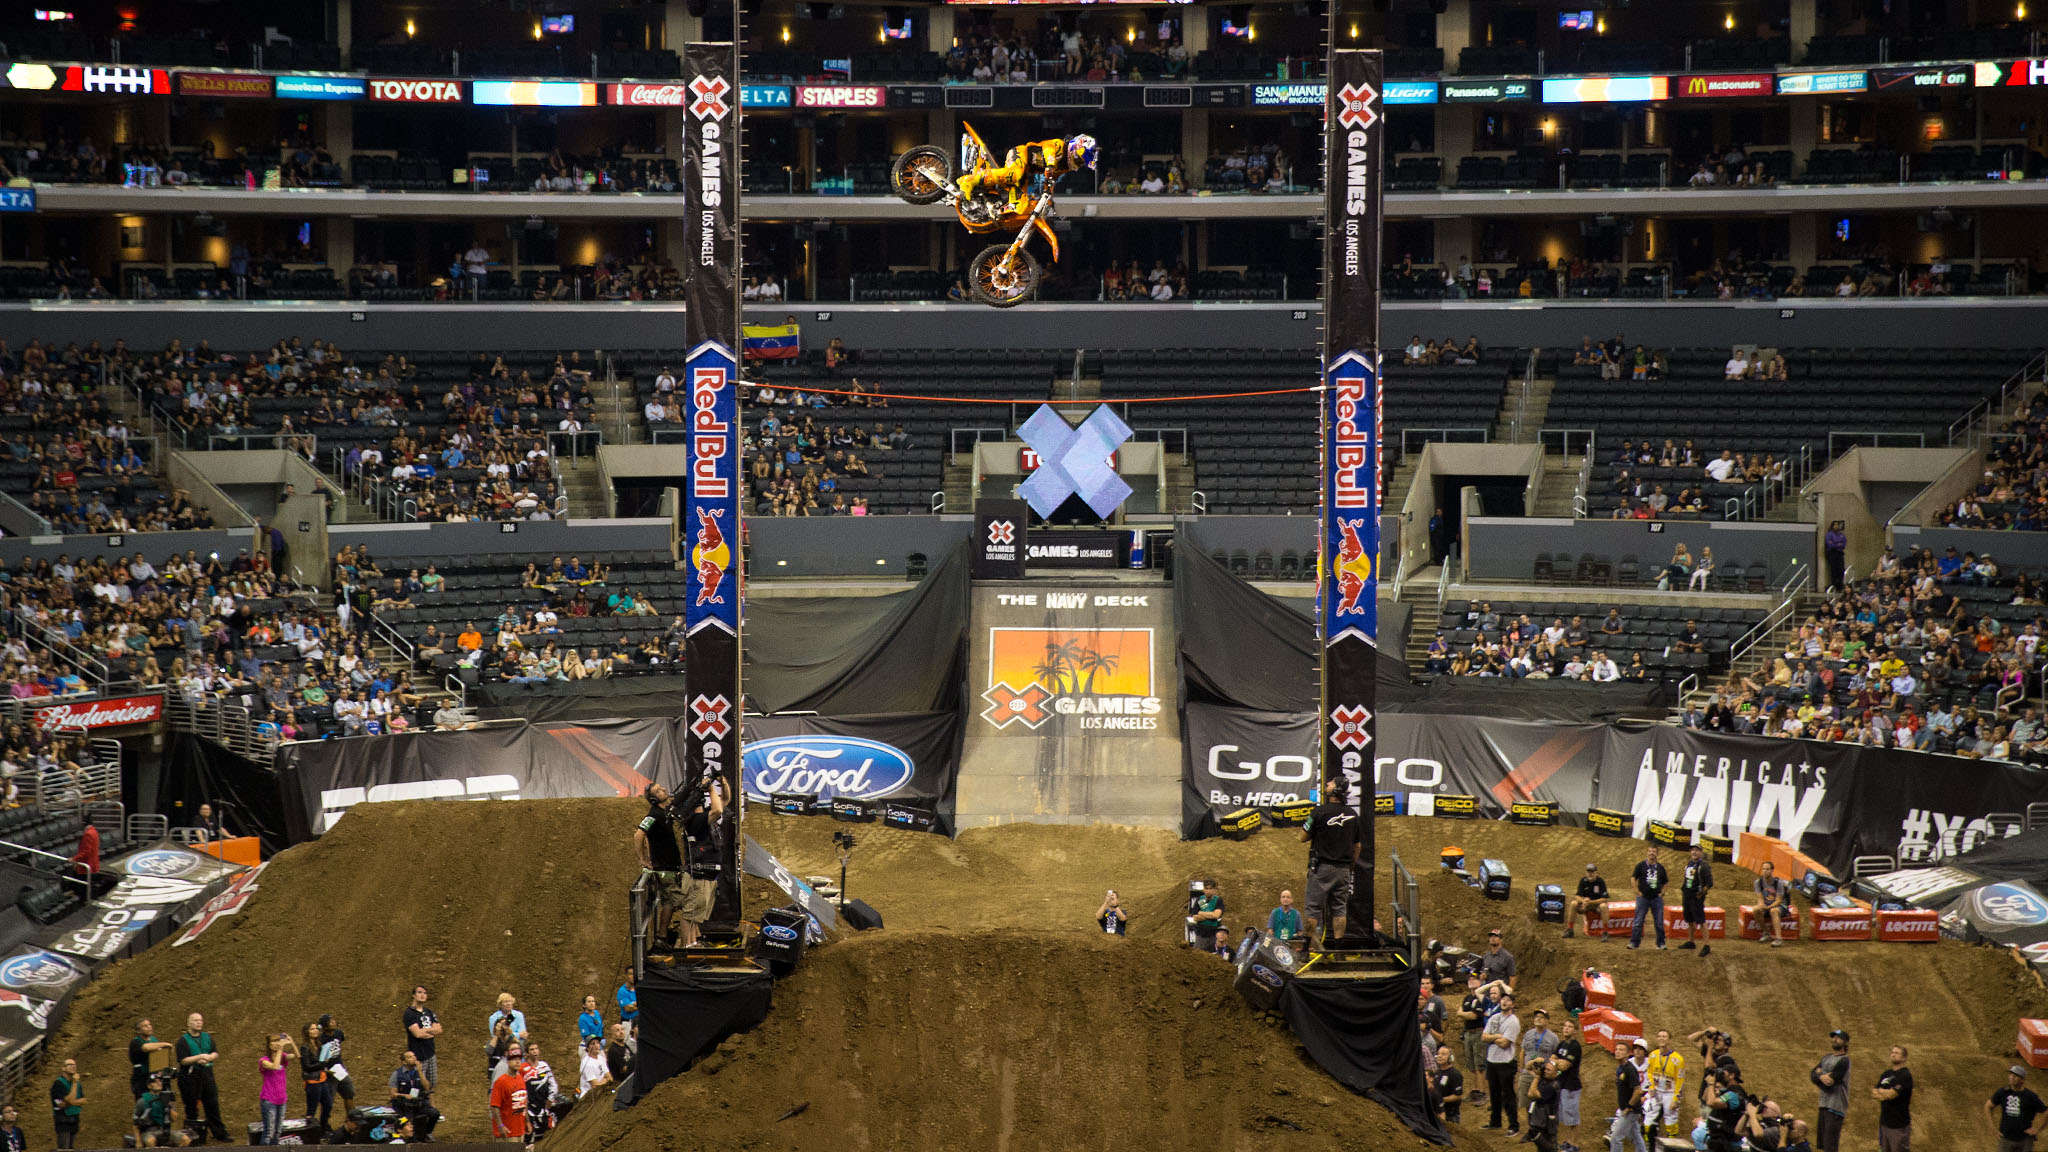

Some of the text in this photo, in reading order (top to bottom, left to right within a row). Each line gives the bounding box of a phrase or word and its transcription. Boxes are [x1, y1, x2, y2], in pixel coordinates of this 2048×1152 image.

[1708, 80, 1761, 91] McDonald's
[1914, 72, 1966, 86] verizon
[182, 80, 270, 92] WELLS FARGO
[277, 81, 363, 95] American Express
[370, 81, 460, 100] TOYOTA
[1255, 86, 1328, 97] SAN MANUE
[1446, 85, 1526, 97] Panasonic 3D
[741, 90, 788, 103] ELTA
[803, 87, 878, 106] STAPLES
[1390, 88, 1434, 98] LIGHT
[0, 193, 32, 207] LTA
[701, 122, 721, 266] GAMES LOS ANGELES
[1345, 130, 1368, 276] GAMES LOS ANGELES
[818, 312, 831, 321] 207
[1293, 311, 1307, 320] 208
[693, 367, 729, 498] Red Bull
[1335, 377, 1368, 508] Red Bull
[503, 523, 515, 532] 106
[986, 544, 1015, 553] GAMES
[1028, 545, 1112, 558] GAMES LOS ANGELES
[997, 592, 1149, 609] THE NAVY DECK
[1054, 697, 1161, 715] GAMES
[38, 701, 157, 731] Budweiser
[1080, 717, 1157, 730] LOS ANGELES
[755, 746, 874, 793] Ford
[1208, 745, 1443, 787] Goro
[773, 798, 804, 807] GoPro
[1210, 789, 1299, 807] Be a HERO
[1435, 798, 1474, 808] GEICO
[833, 802, 862, 812] GoPro
[1512, 804, 1549, 815] GEICO
[1588, 812, 1622, 827] GEICO
[1649, 823, 1675, 839] GEICO
[1819, 920, 1870, 931] LOCTITE
[1885, 921, 1936, 932] LOCTITE
